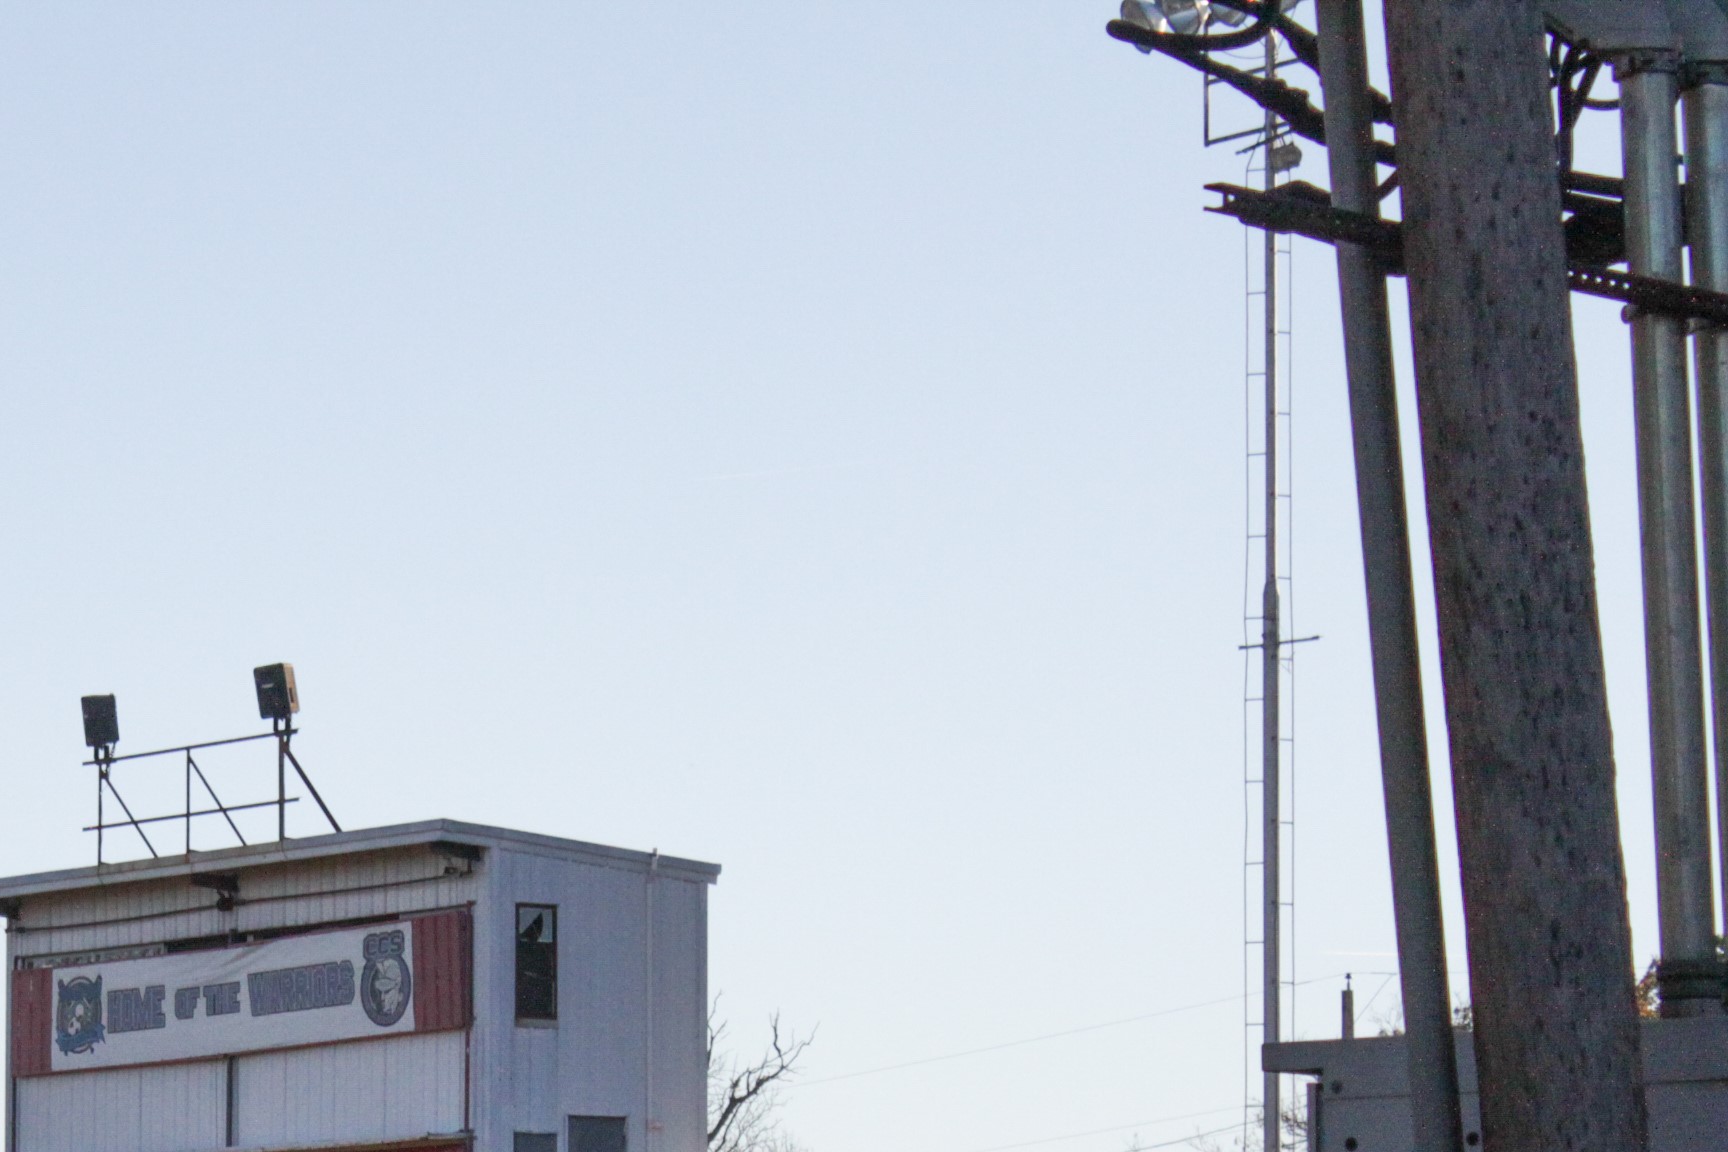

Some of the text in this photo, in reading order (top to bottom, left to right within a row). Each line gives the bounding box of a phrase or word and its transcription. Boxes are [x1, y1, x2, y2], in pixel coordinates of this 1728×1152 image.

[364, 930, 404, 959] CCS
[107, 960, 355, 1034] HOME OF THE WARRIORS
